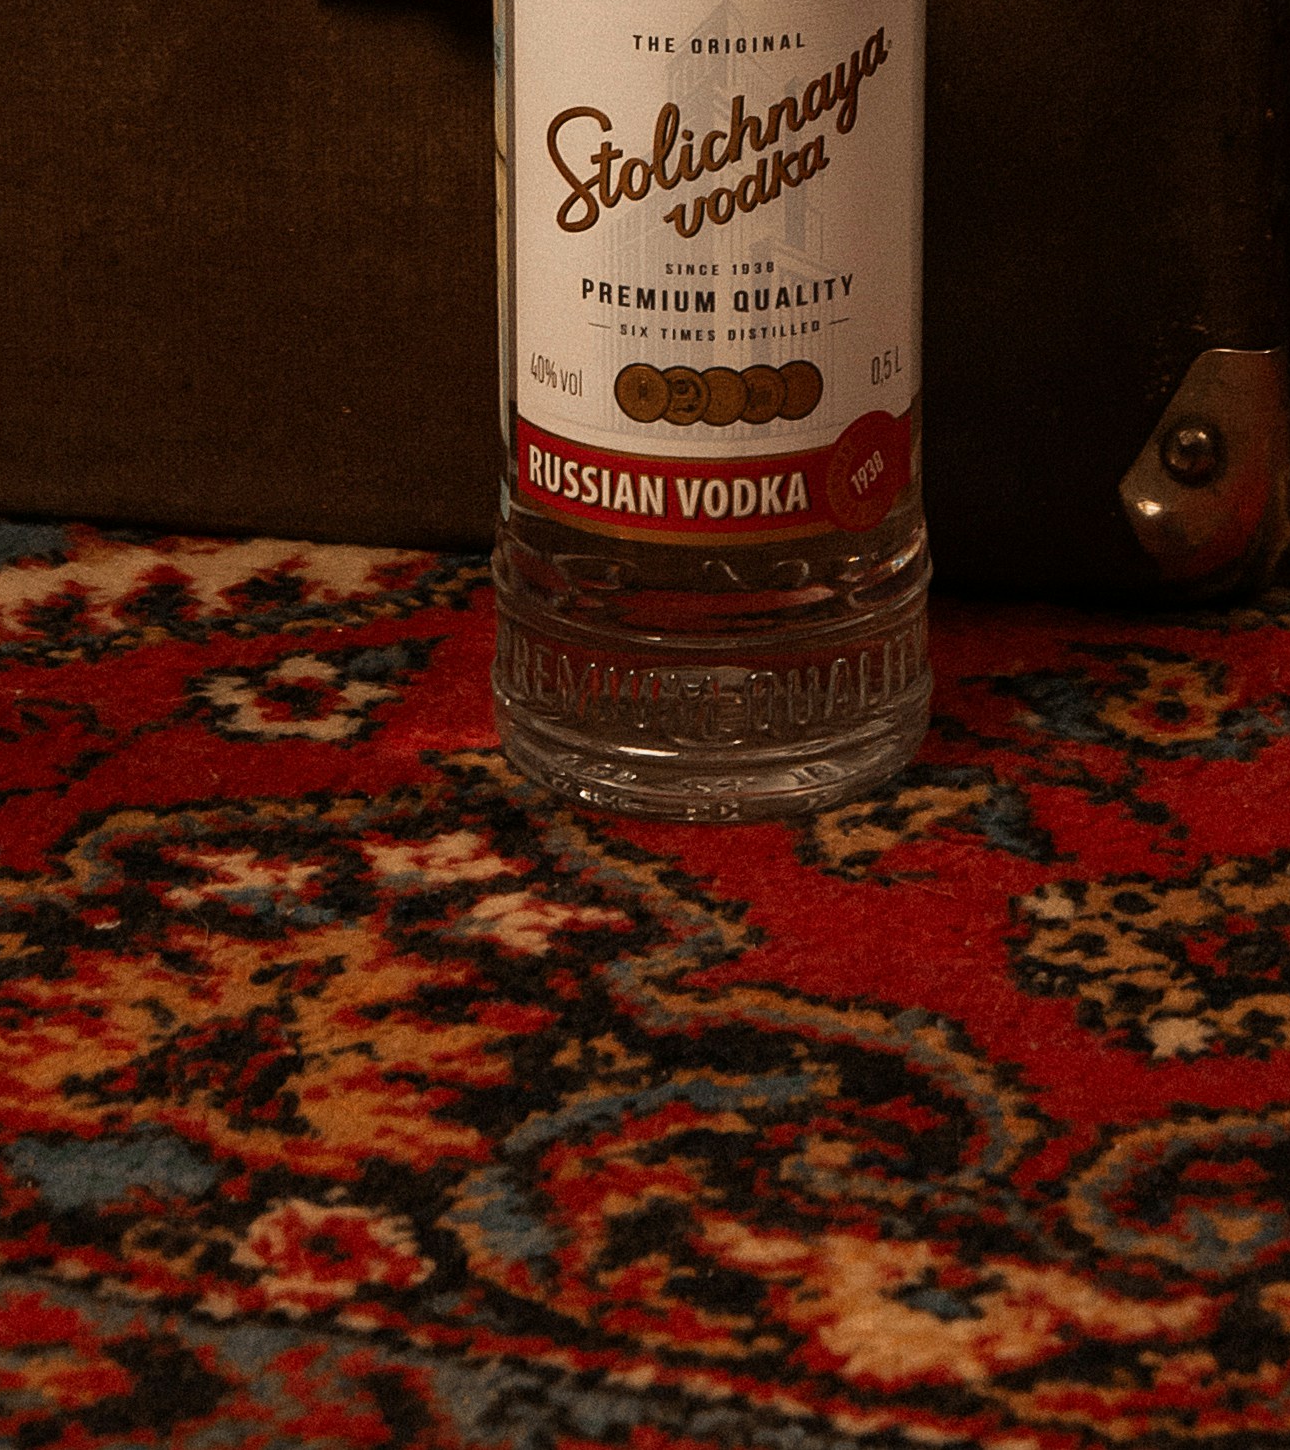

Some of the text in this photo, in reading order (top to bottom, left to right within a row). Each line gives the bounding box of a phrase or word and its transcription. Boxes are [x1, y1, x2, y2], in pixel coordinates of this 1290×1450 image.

[632, 32, 807, 54] THE ORIGINAL
[547, 27, 890, 233] Stolichnaya
[663, 135, 831, 239] vodka
[664, 260, 776, 276] SINCE 1938
[581, 273, 854, 314] PREMIUM QUALITY
[619, 320, 821, 343] SIX TIMES DISTILLED
[530, 351, 559, 390] 40%
[559, 367, 584, 398] vol
[528, 443, 668, 518] RUSSIAN
[674, 470, 810, 520] VODKA
[850, 449, 885, 497] 1938
